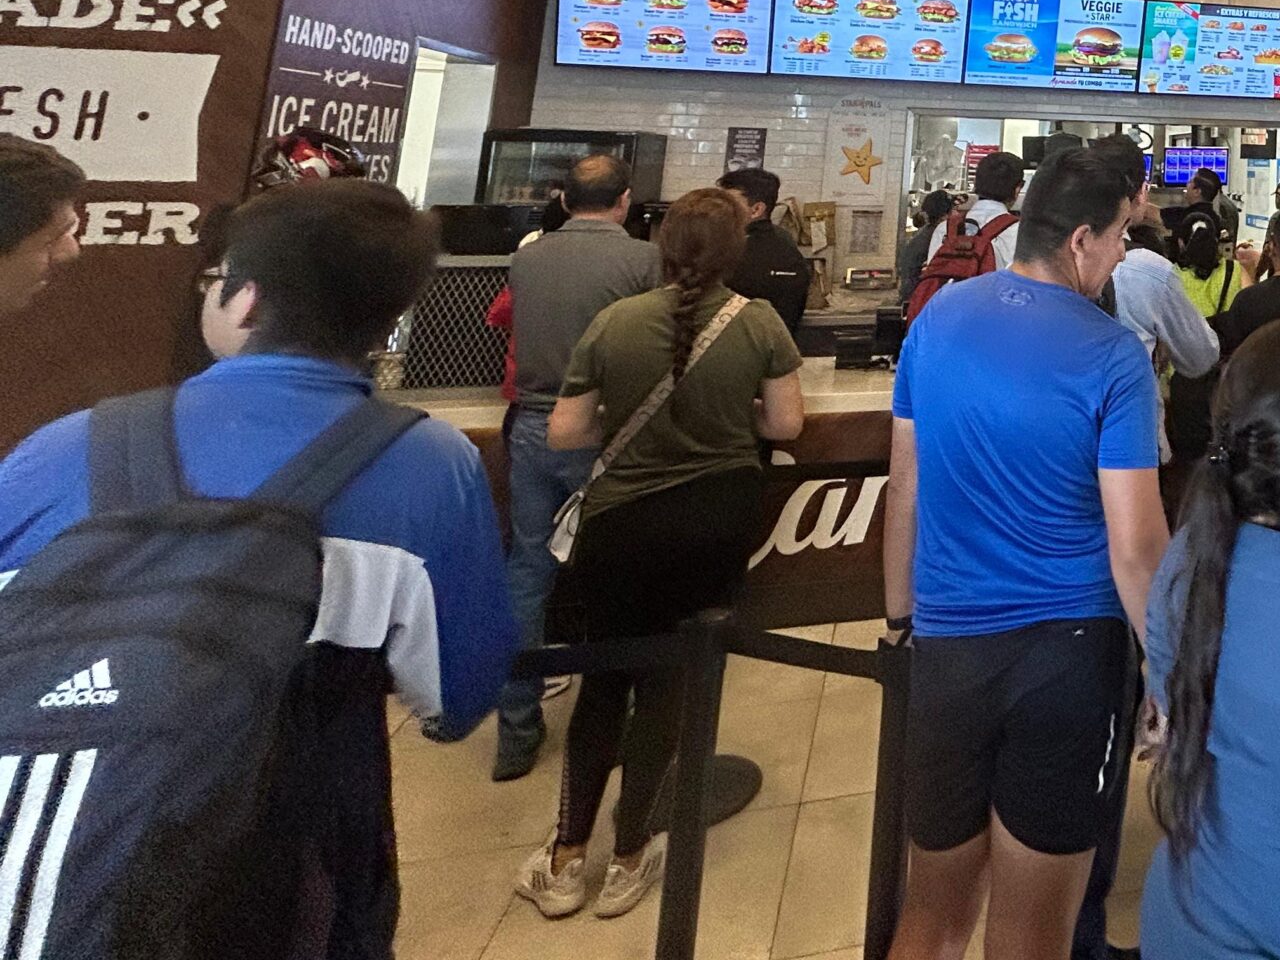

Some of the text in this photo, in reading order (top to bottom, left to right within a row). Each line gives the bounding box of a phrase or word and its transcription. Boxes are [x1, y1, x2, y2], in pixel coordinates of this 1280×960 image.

[1081, 0, 1123, 14] VEGGIE
[1090, 12, 1111, 21] STAR
[285, 15, 410, 65] HAND-SCOOPED
[267, 95, 400, 144] ICE CREAM
[38, 688, 119, 708] adidas
